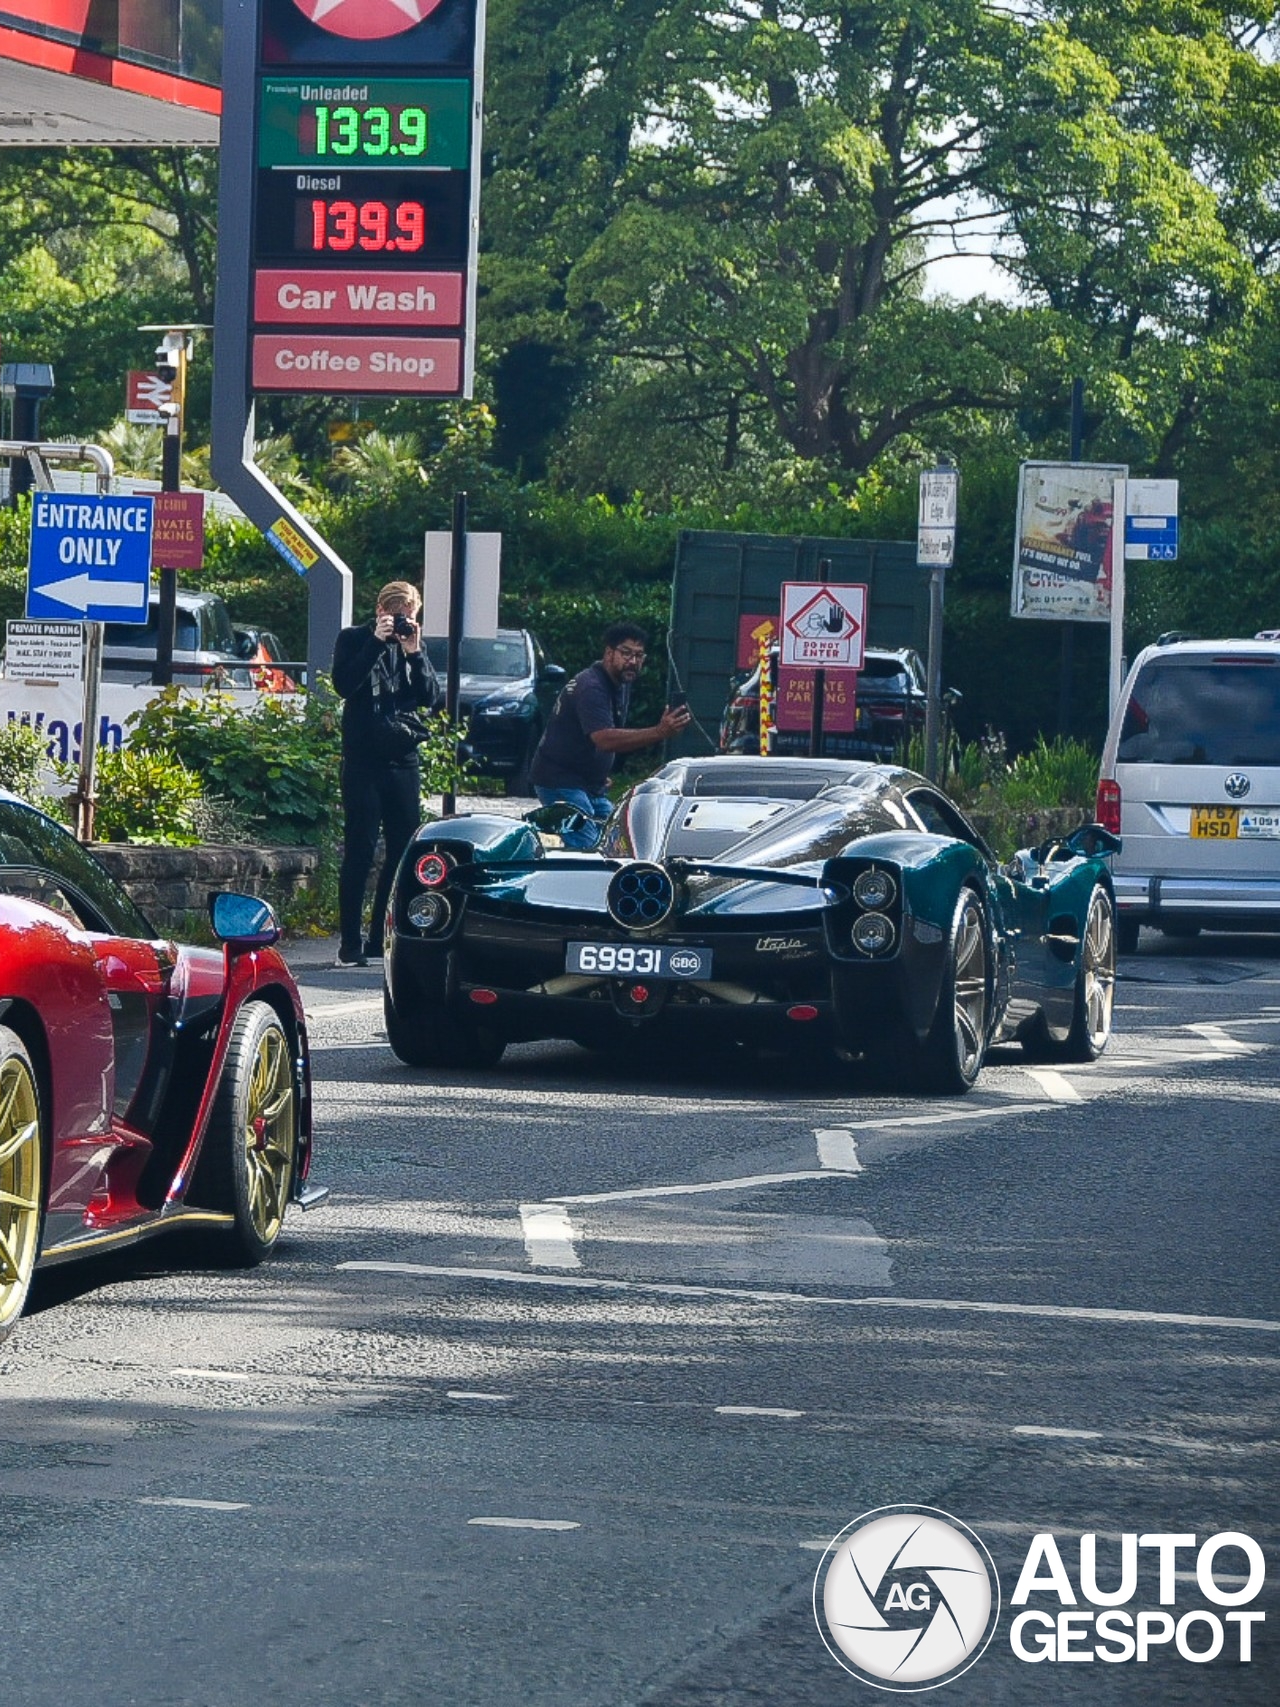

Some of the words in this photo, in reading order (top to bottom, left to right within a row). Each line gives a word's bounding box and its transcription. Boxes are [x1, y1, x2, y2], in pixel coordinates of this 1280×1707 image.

[301, 85, 368, 101] Unleaded
[315, 106, 428, 156] 133.9
[296, 175, 341, 191] Diesel
[312, 200, 425, 252] 139.9
[277, 283, 337, 310] Car
[347, 284, 437, 312] Wash
[274, 349, 361, 371] Coffee
[369, 351, 436, 378] Shop
[37, 503, 147, 533] ENTRANCE
[157, 519, 193, 530] IVATE
[154, 531, 194, 541] RKING
[59, 537, 123, 566] ONLY
[10, 623, 42, 634] PRIVATE
[44, 624, 80, 635] PARKING
[803, 641, 818, 649] DO
[802, 649, 840, 658] ENTER
[786, 691, 846, 705] PARNG
[1197, 821, 1231, 837] HSD
[579, 946, 661, 973] 69931
[673, 956, 699, 970] GBG
